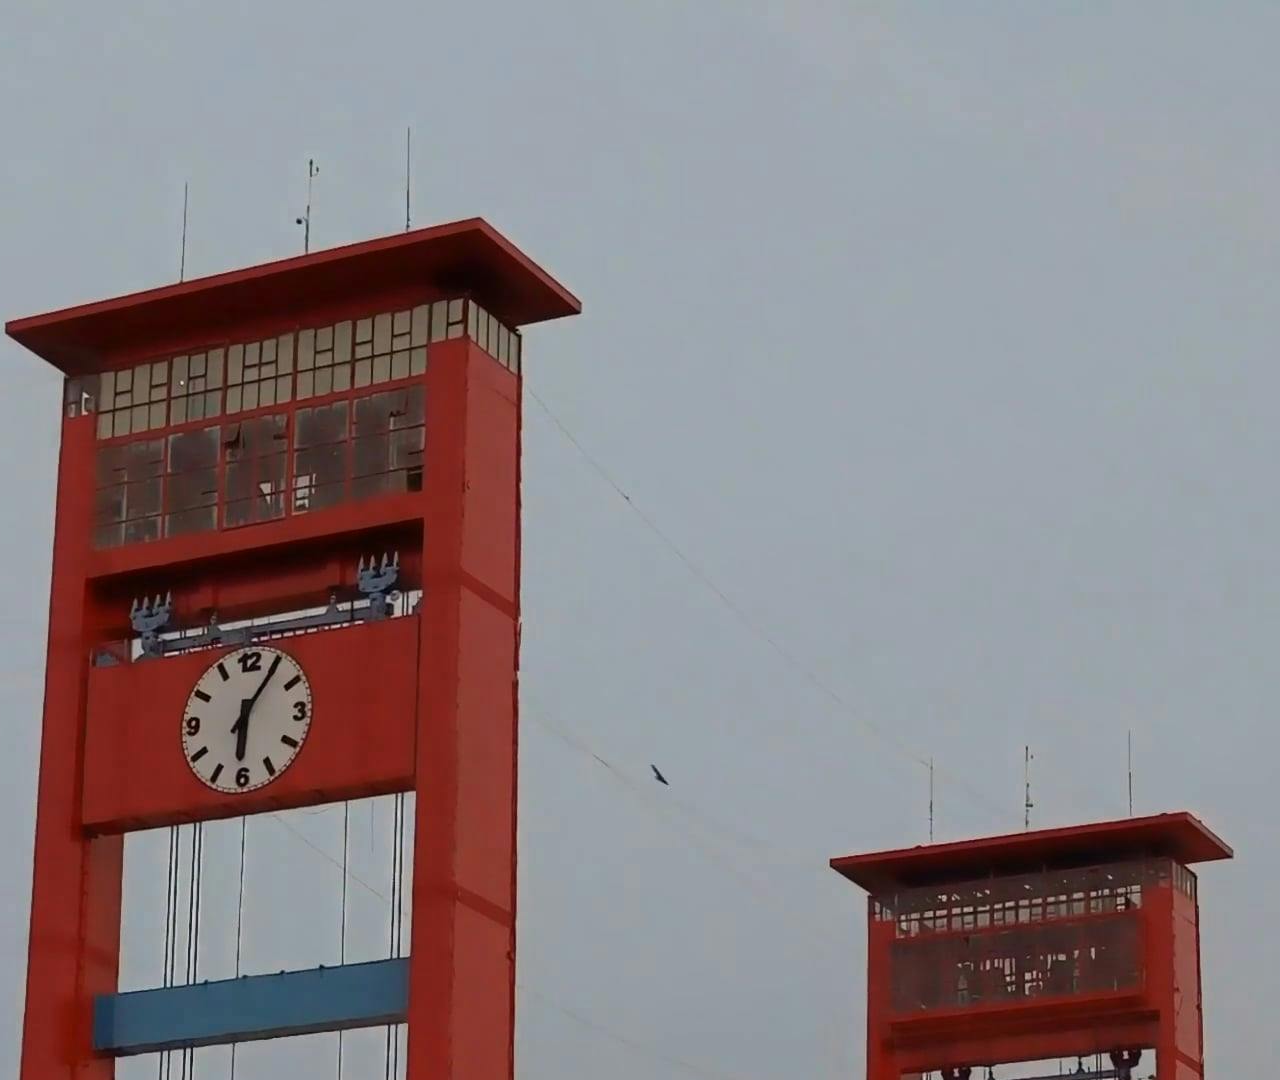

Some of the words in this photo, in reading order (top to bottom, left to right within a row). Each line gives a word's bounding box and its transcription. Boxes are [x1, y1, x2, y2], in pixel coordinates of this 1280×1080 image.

[237, 651, 262, 673] 12
[292, 700, 307, 721] 3
[185, 716, 201, 736] 9
[235, 767, 250, 787] 6
